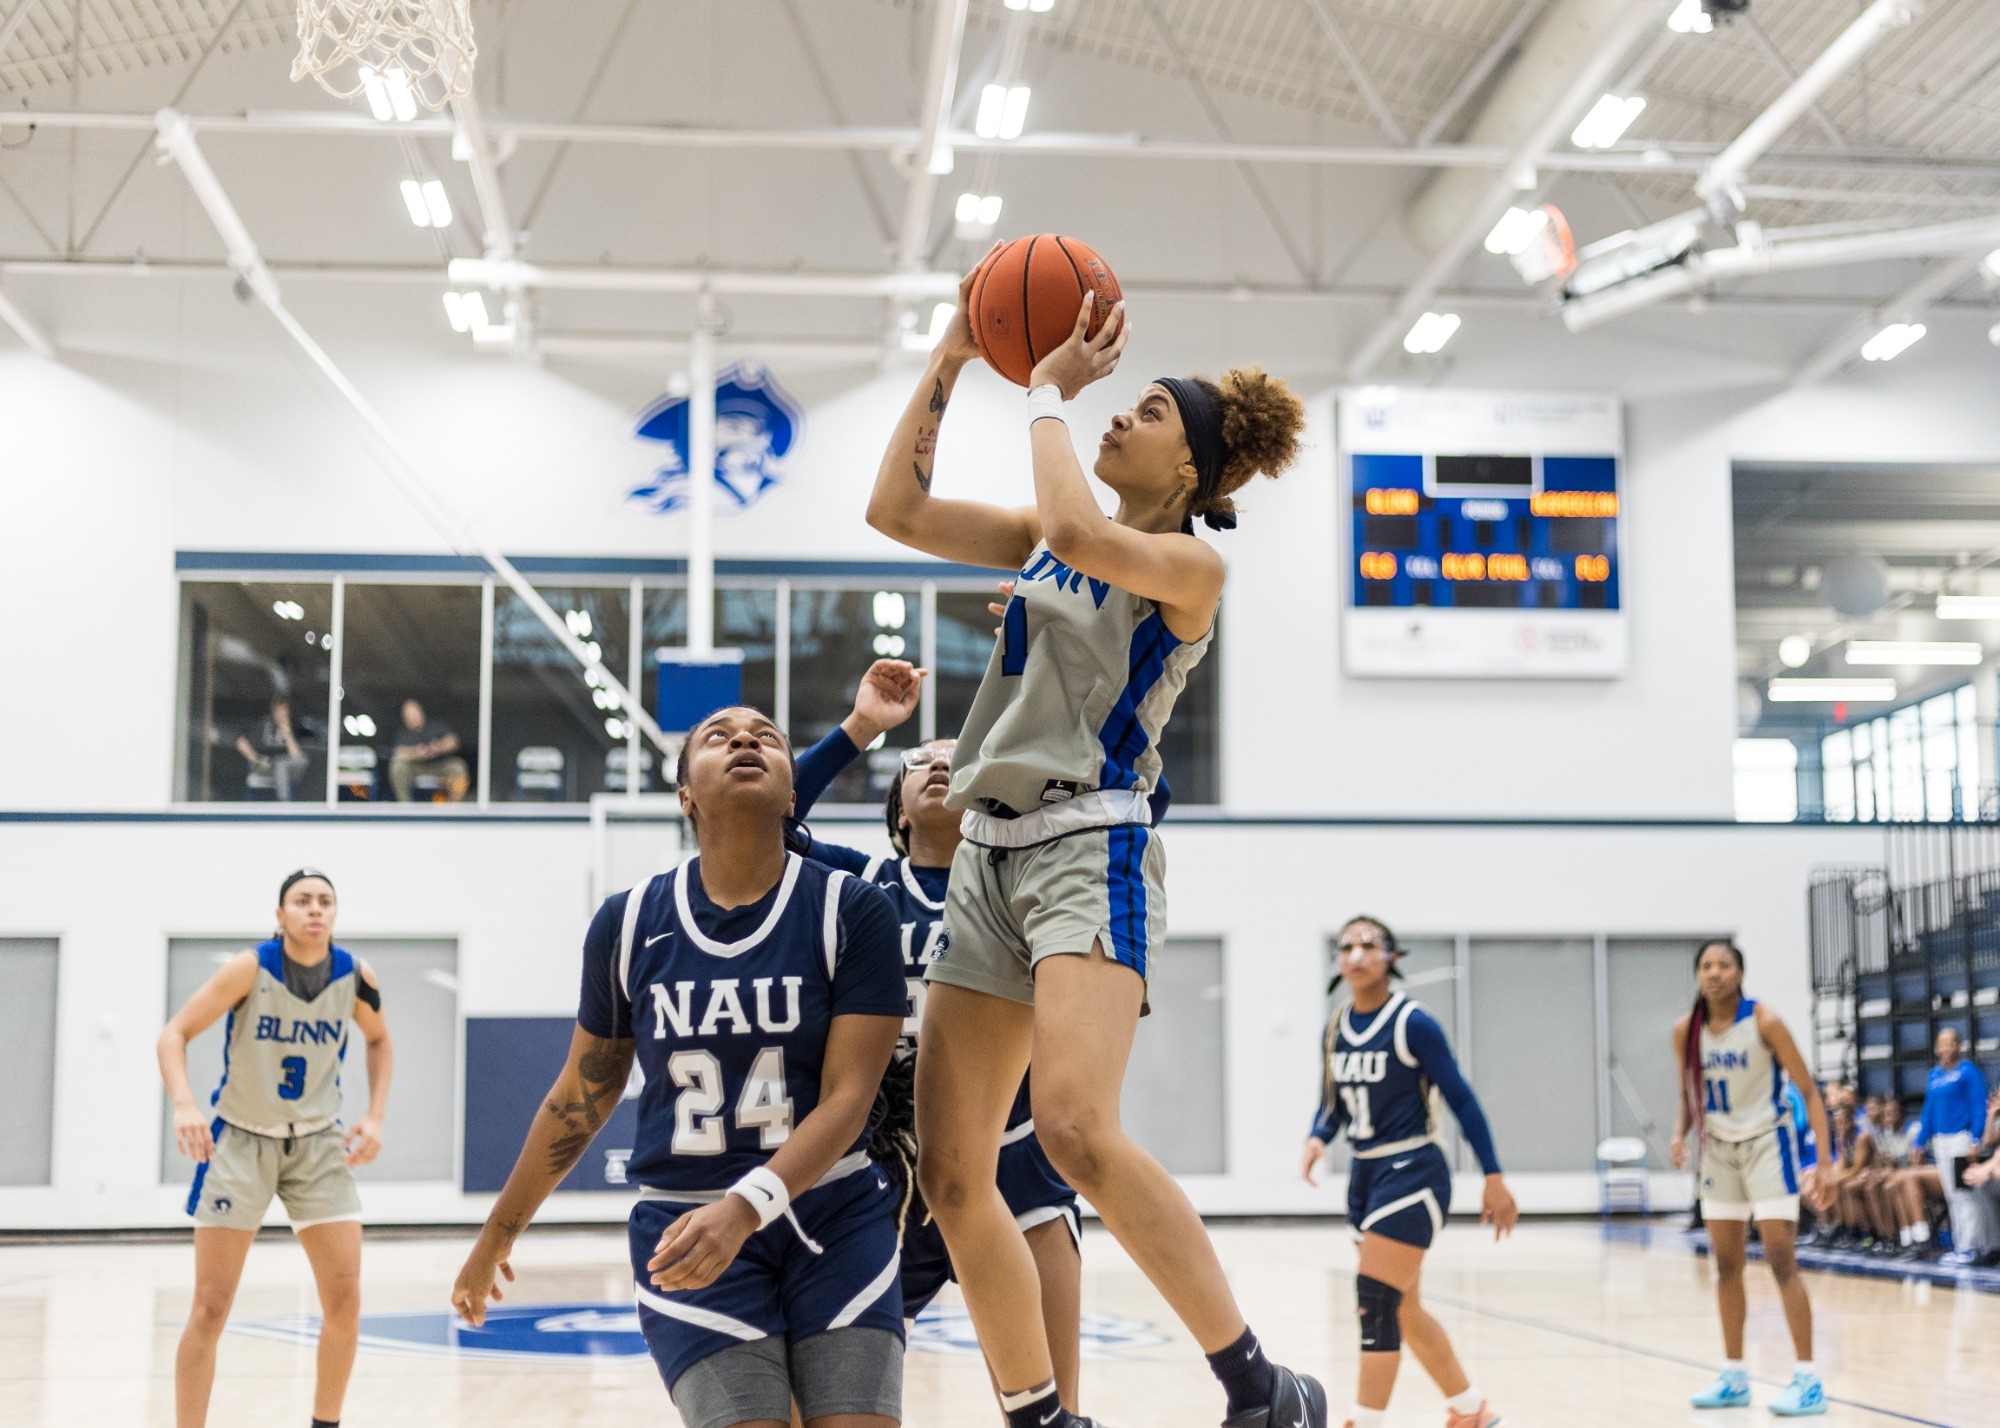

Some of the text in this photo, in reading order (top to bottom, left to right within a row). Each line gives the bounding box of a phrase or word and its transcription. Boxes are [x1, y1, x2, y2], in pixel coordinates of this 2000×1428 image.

[1056, 780, 1064, 788] L
[255, 1014, 342, 1045] BLINN
[650, 976, 803, 1039] NAU
[277, 1055, 308, 1101] 3
[667, 1046, 795, 1156] 24
